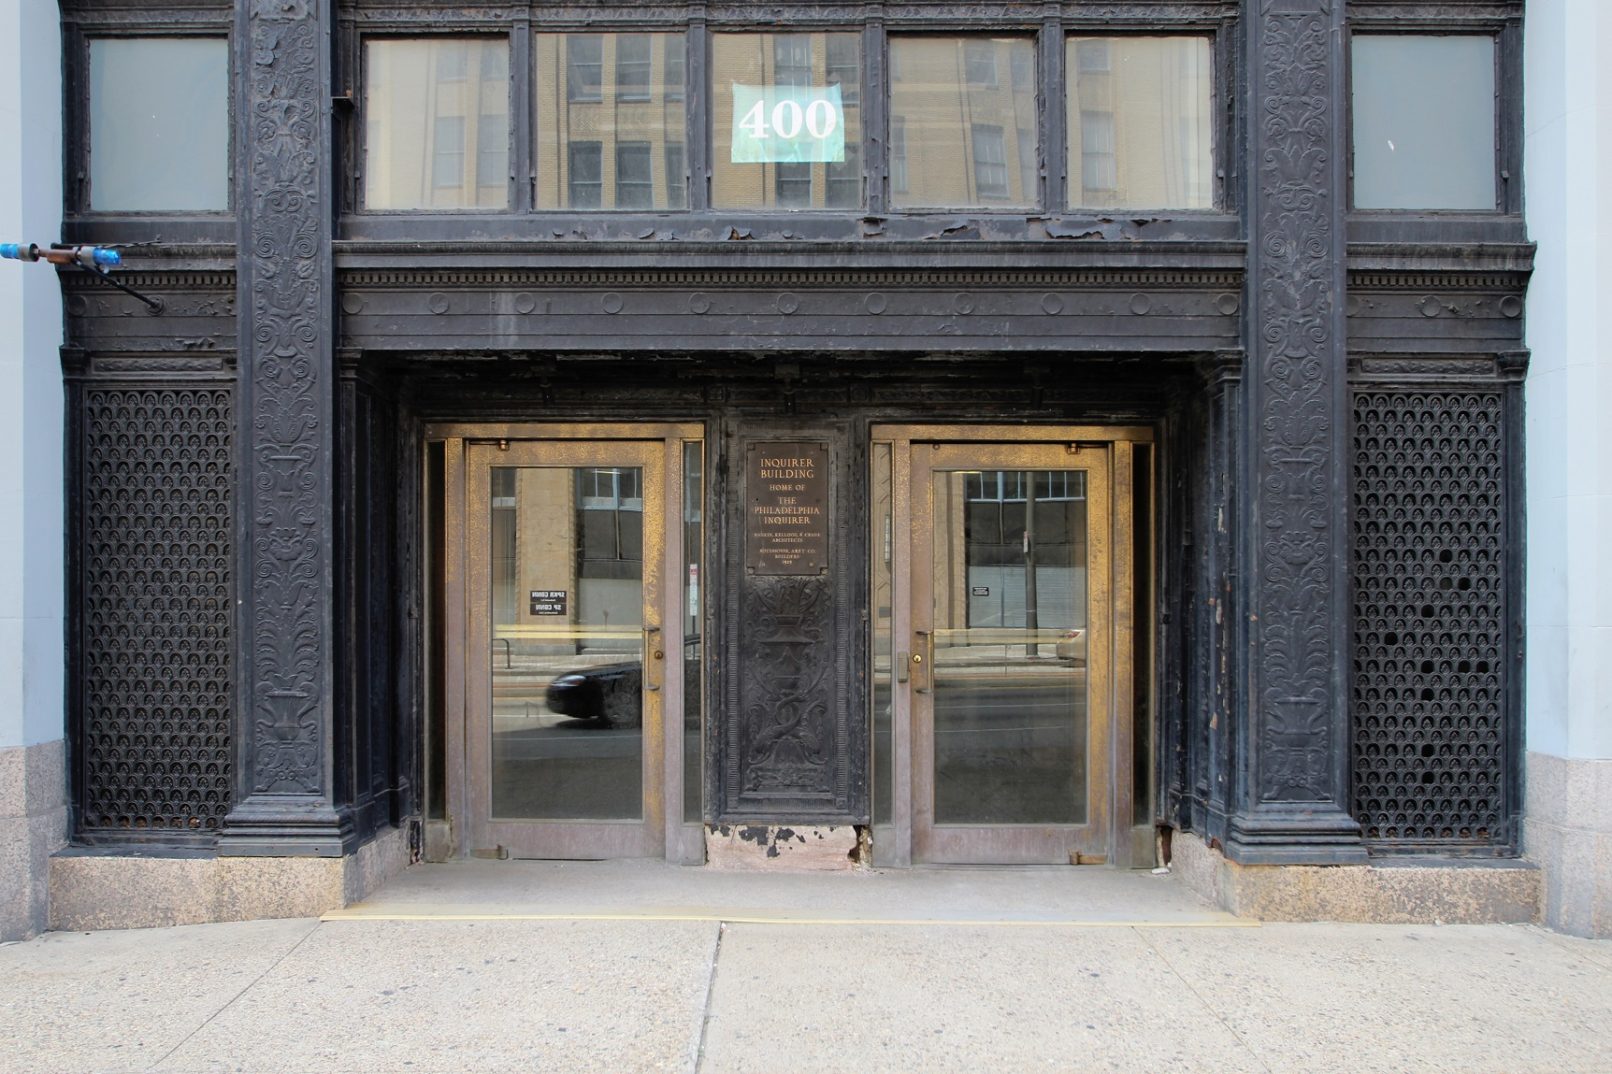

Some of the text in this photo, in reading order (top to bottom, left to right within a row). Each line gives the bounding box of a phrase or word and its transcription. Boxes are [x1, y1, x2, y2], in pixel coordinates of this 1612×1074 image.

[738, 99, 837, 139] 400
[760, 458, 815, 468] INQUIRER
[760, 469, 815, 479] BUILDING
[777, 496, 797, 505] THE
[754, 506, 820, 515] PHILADELPHIA
[764, 516, 811, 525] INQUIRER
